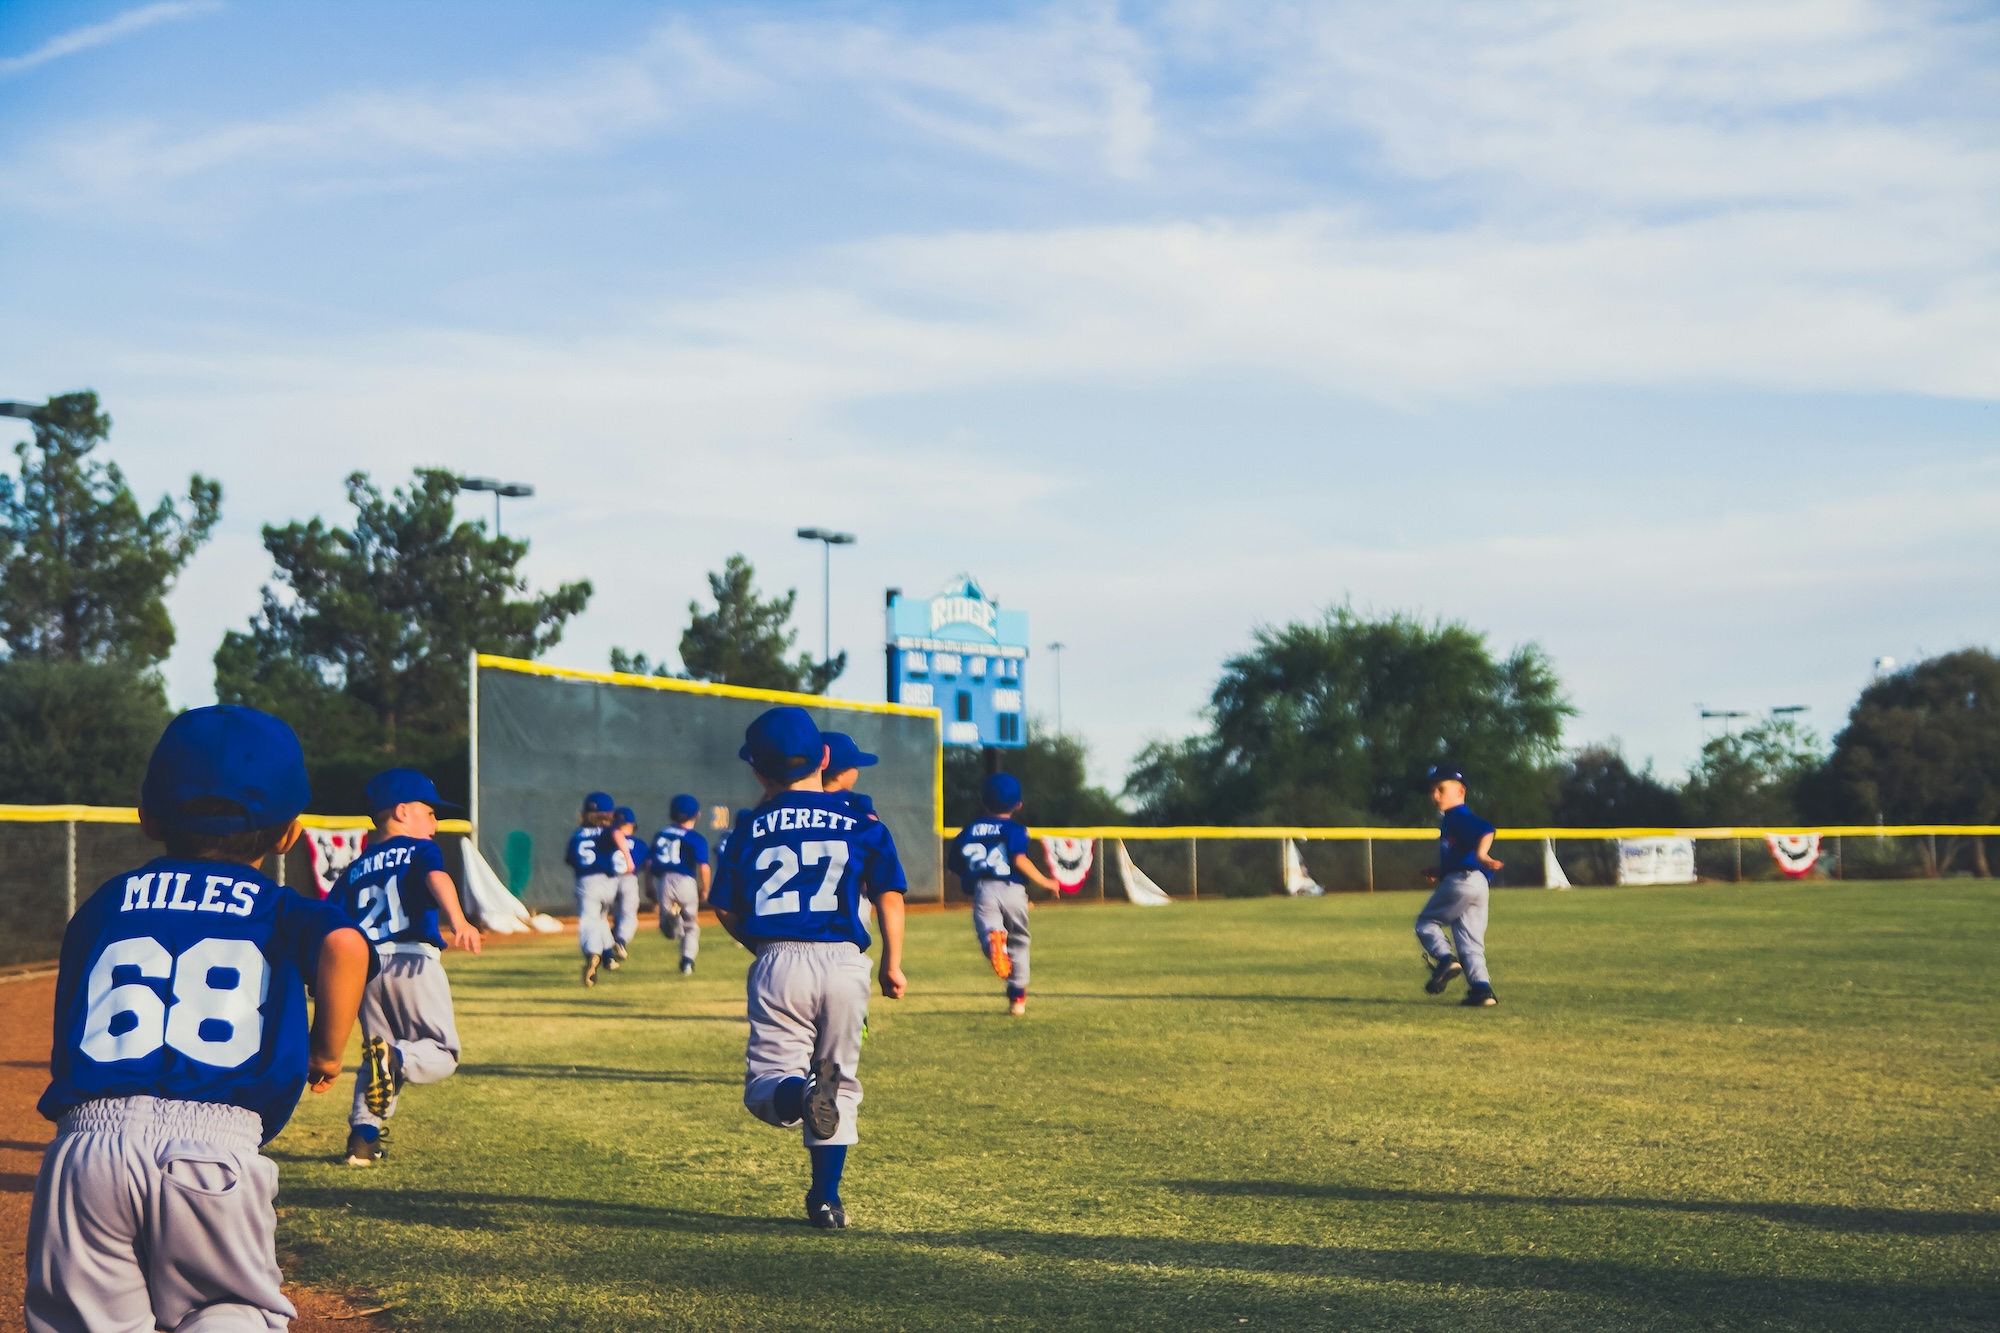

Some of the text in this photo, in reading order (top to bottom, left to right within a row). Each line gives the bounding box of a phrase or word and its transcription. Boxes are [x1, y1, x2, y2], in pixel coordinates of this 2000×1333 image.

[931, 595, 997, 637] RIDGE
[907, 651, 929, 671] BALL
[752, 808, 857, 838] EVERETT
[578, 840, 596, 865] 5
[962, 842, 1011, 876] 24
[120, 872, 260, 917] MILES
[755, 840, 849, 917] 27
[357, 874, 410, 941] 21
[79, 936, 272, 1068] 68
